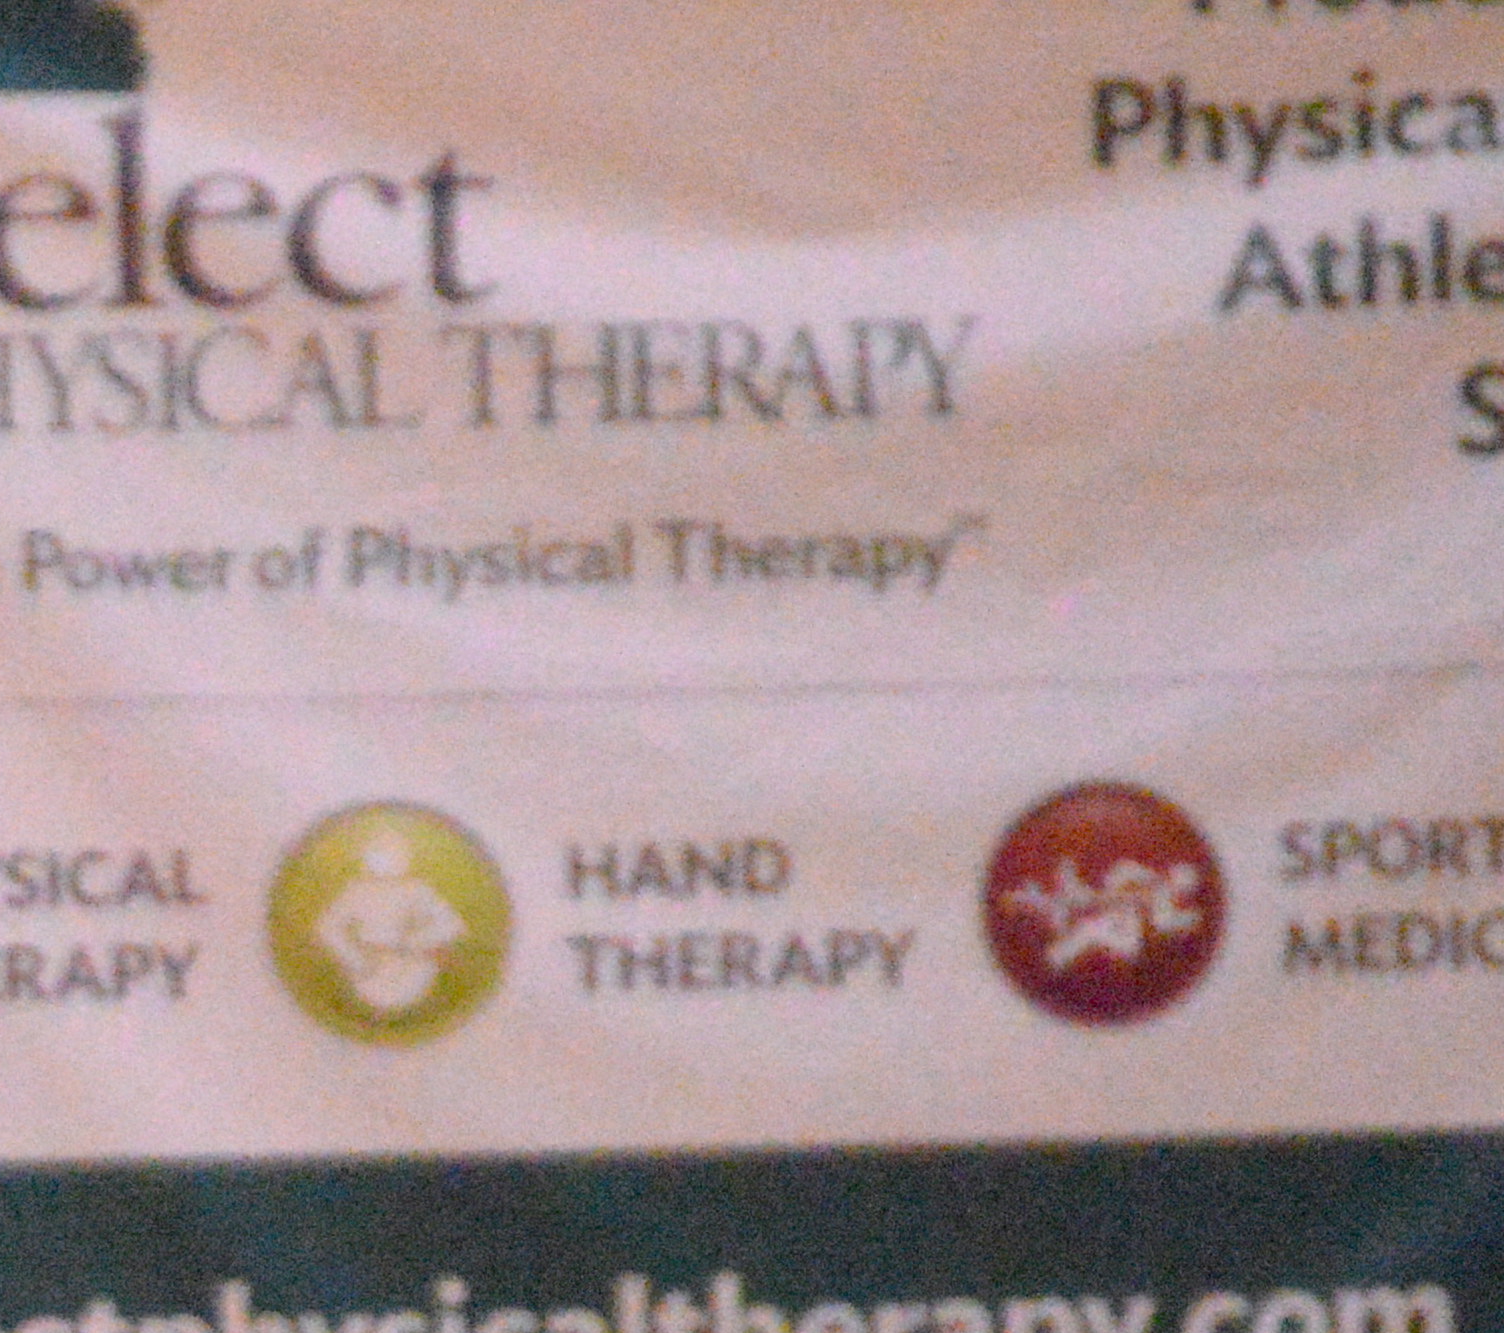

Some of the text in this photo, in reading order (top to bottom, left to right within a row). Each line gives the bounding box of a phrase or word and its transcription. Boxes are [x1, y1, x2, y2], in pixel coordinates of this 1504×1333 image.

[442, 314, 980, 430] THERAPY
[19, 526, 237, 594] Power
[249, 524, 326, 590] of
[345, 521, 634, 602] Physical
[565, 837, 792, 901] HAND
[566, 928, 918, 995] THERAPY
